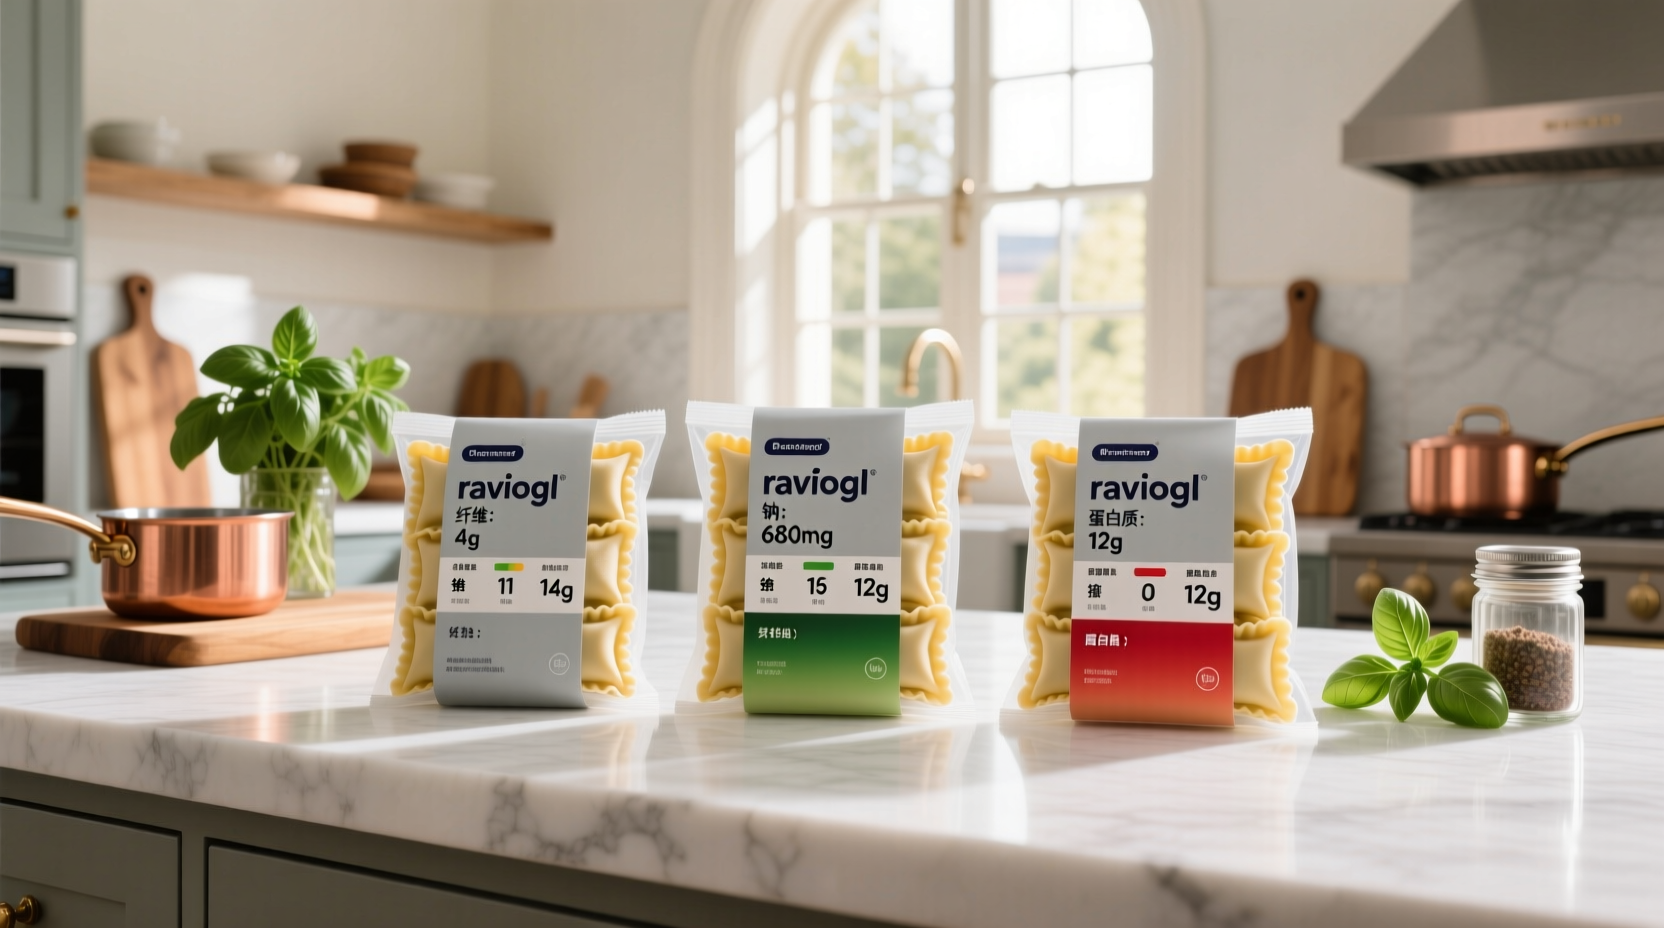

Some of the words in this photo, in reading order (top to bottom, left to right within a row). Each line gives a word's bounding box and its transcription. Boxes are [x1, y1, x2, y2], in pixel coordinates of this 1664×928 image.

[458, 473, 559, 507] raviogl
[763, 467, 868, 503] raviogl
[1090, 473, 1199, 509] raviogl
[1088, 508, 1145, 528] 蛋白质：
[455, 528, 480, 551] 4g
[761, 525, 833, 549] 680mg
[1088, 531, 1123, 555] 12g
[497, 577, 514, 595] 11
[540, 578, 573, 603] 14g
[854, 578, 889, 603] 12g
[1141, 583, 1156, 602] 0
[1184, 584, 1222, 611] 12g
